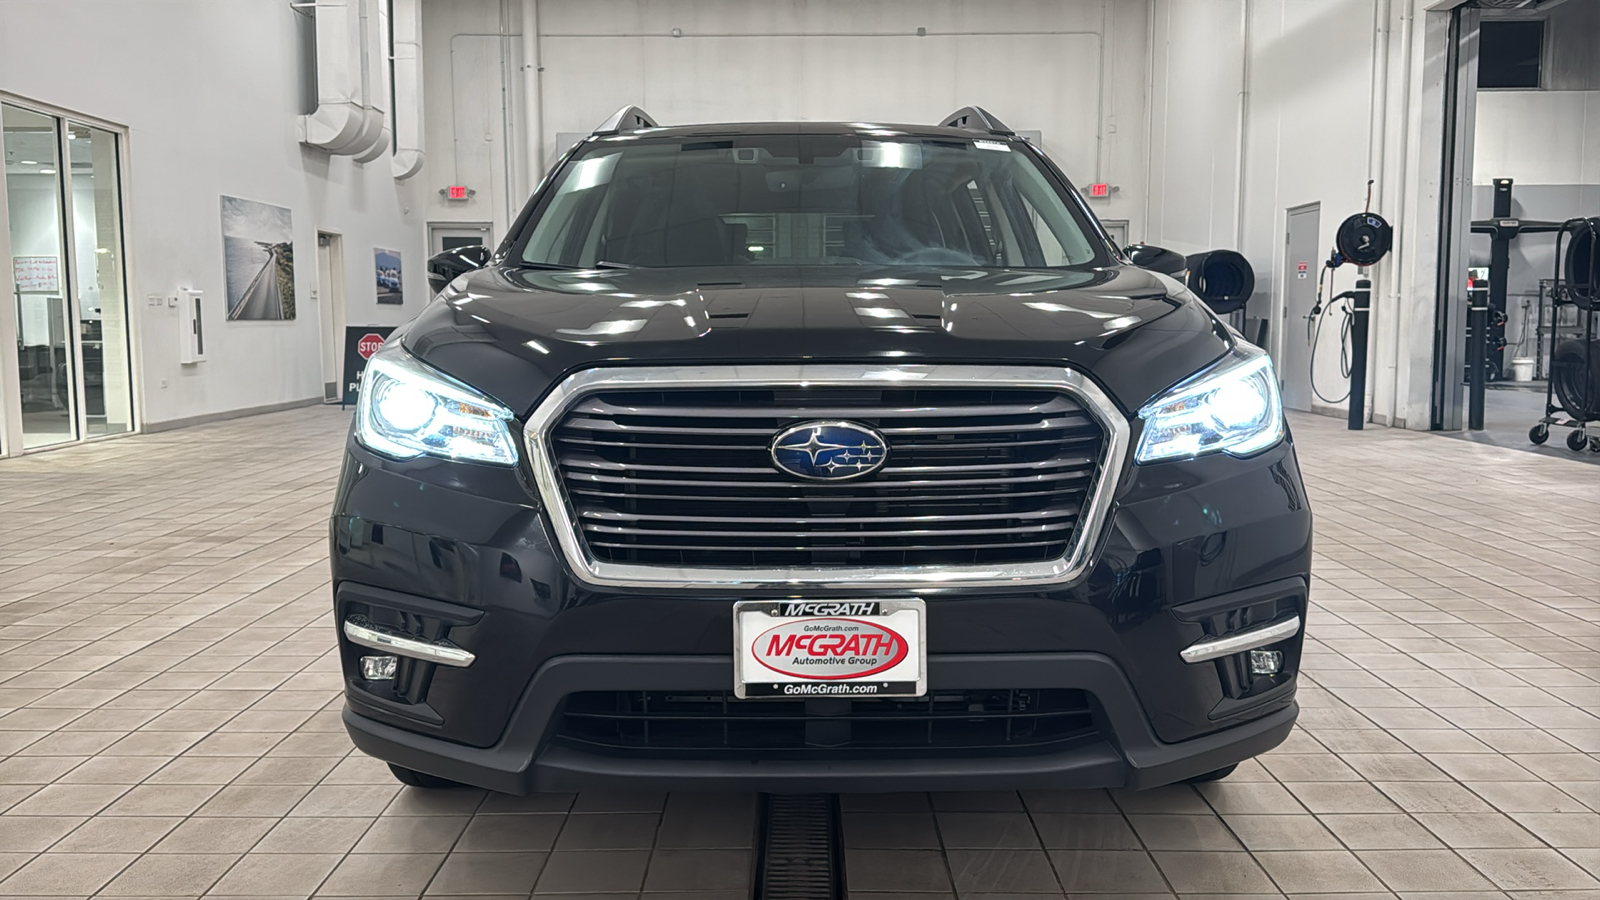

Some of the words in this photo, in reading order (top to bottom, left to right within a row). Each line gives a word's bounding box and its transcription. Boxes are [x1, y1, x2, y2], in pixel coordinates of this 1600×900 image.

[792, 656, 846, 665] Automotive
[848, 657, 878, 666] Group
[784, 683, 878, 695] GoMcGrath.com
